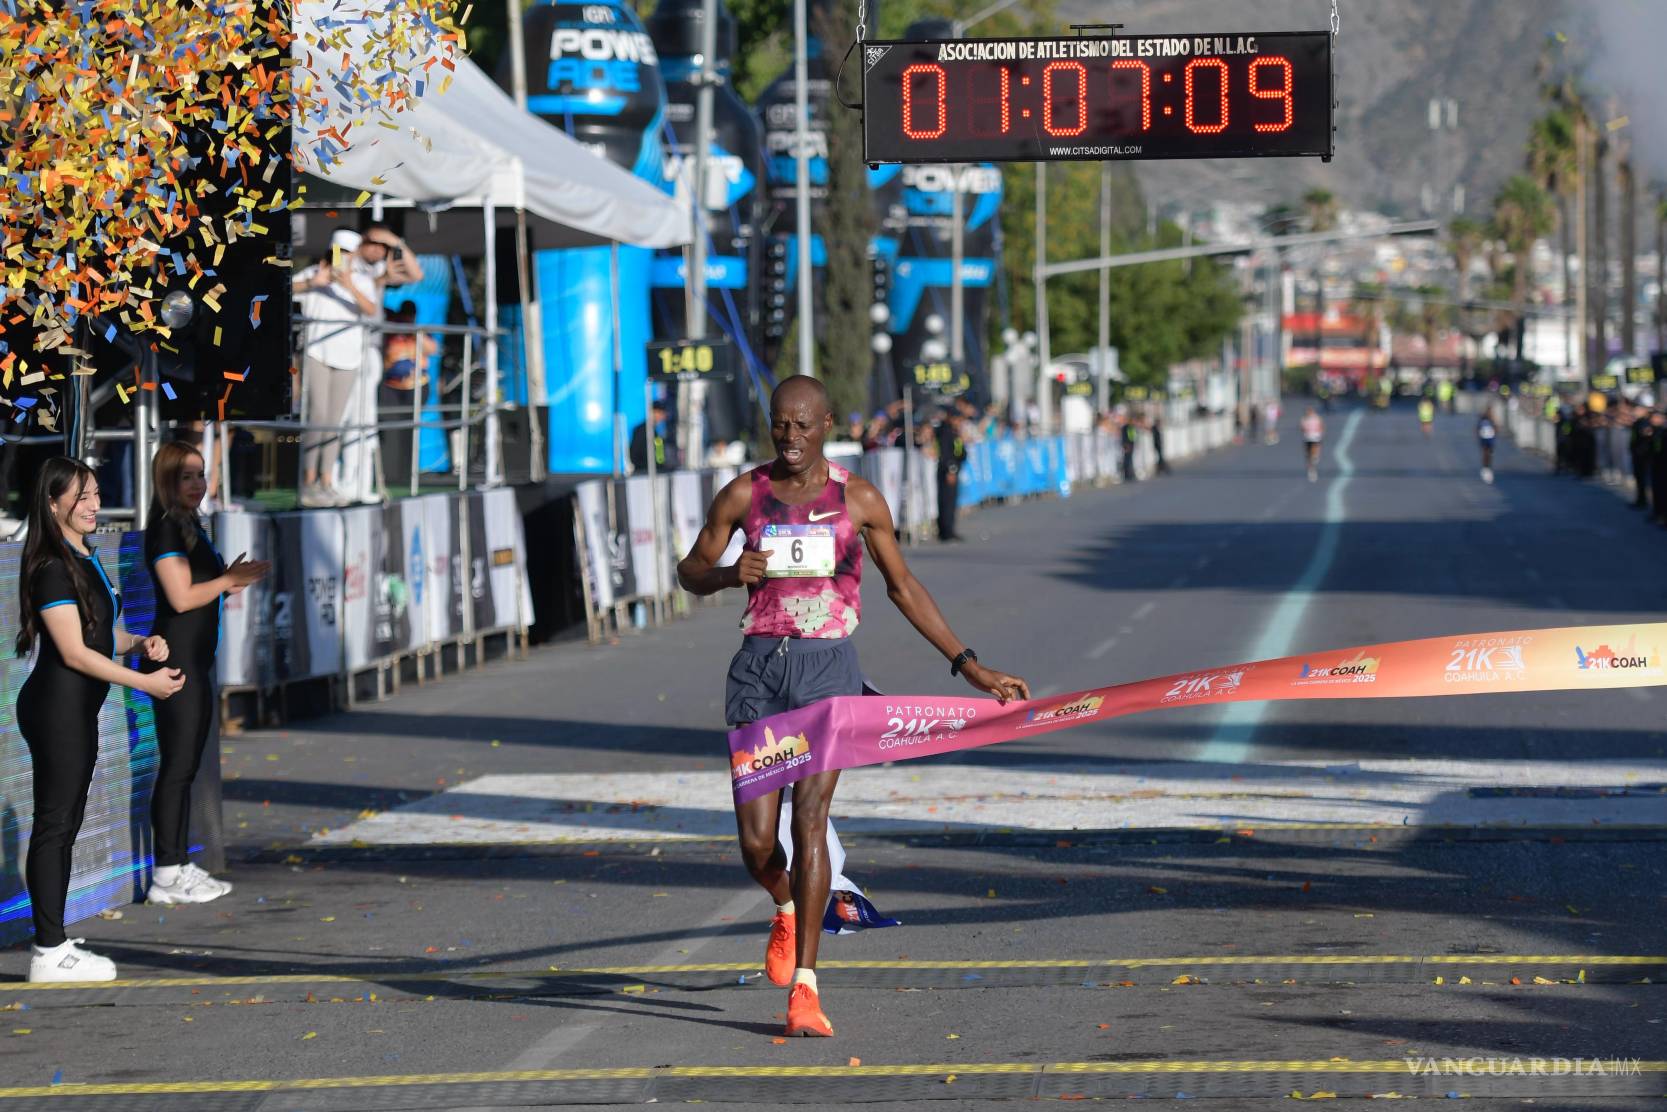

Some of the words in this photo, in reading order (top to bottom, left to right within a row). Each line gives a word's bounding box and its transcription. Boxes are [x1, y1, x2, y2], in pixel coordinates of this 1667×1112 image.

[938, 43, 1015, 61] ASOCIACION
[1018, 42, 1035, 59] DE
[1111, 39, 1134, 57] DEL
[1137, 38, 1190, 57] ESTADO
[1194, 37, 1211, 56] DE
[1049, 145, 1142, 156] WWW.CITSADIGITAL.COM
[658, 345, 713, 373] 1:40
[791, 538, 804, 563] 6
[1445, 648, 1497, 671] 21K
[1165, 675, 1219, 697] 21K
[1352, 674, 1376, 683] 2025
[886, 705, 976, 719] PATRONATO
[881, 717, 940, 738] 21K
[878, 734, 931, 750] COAHUILA
[785, 751, 812, 770] 2025
